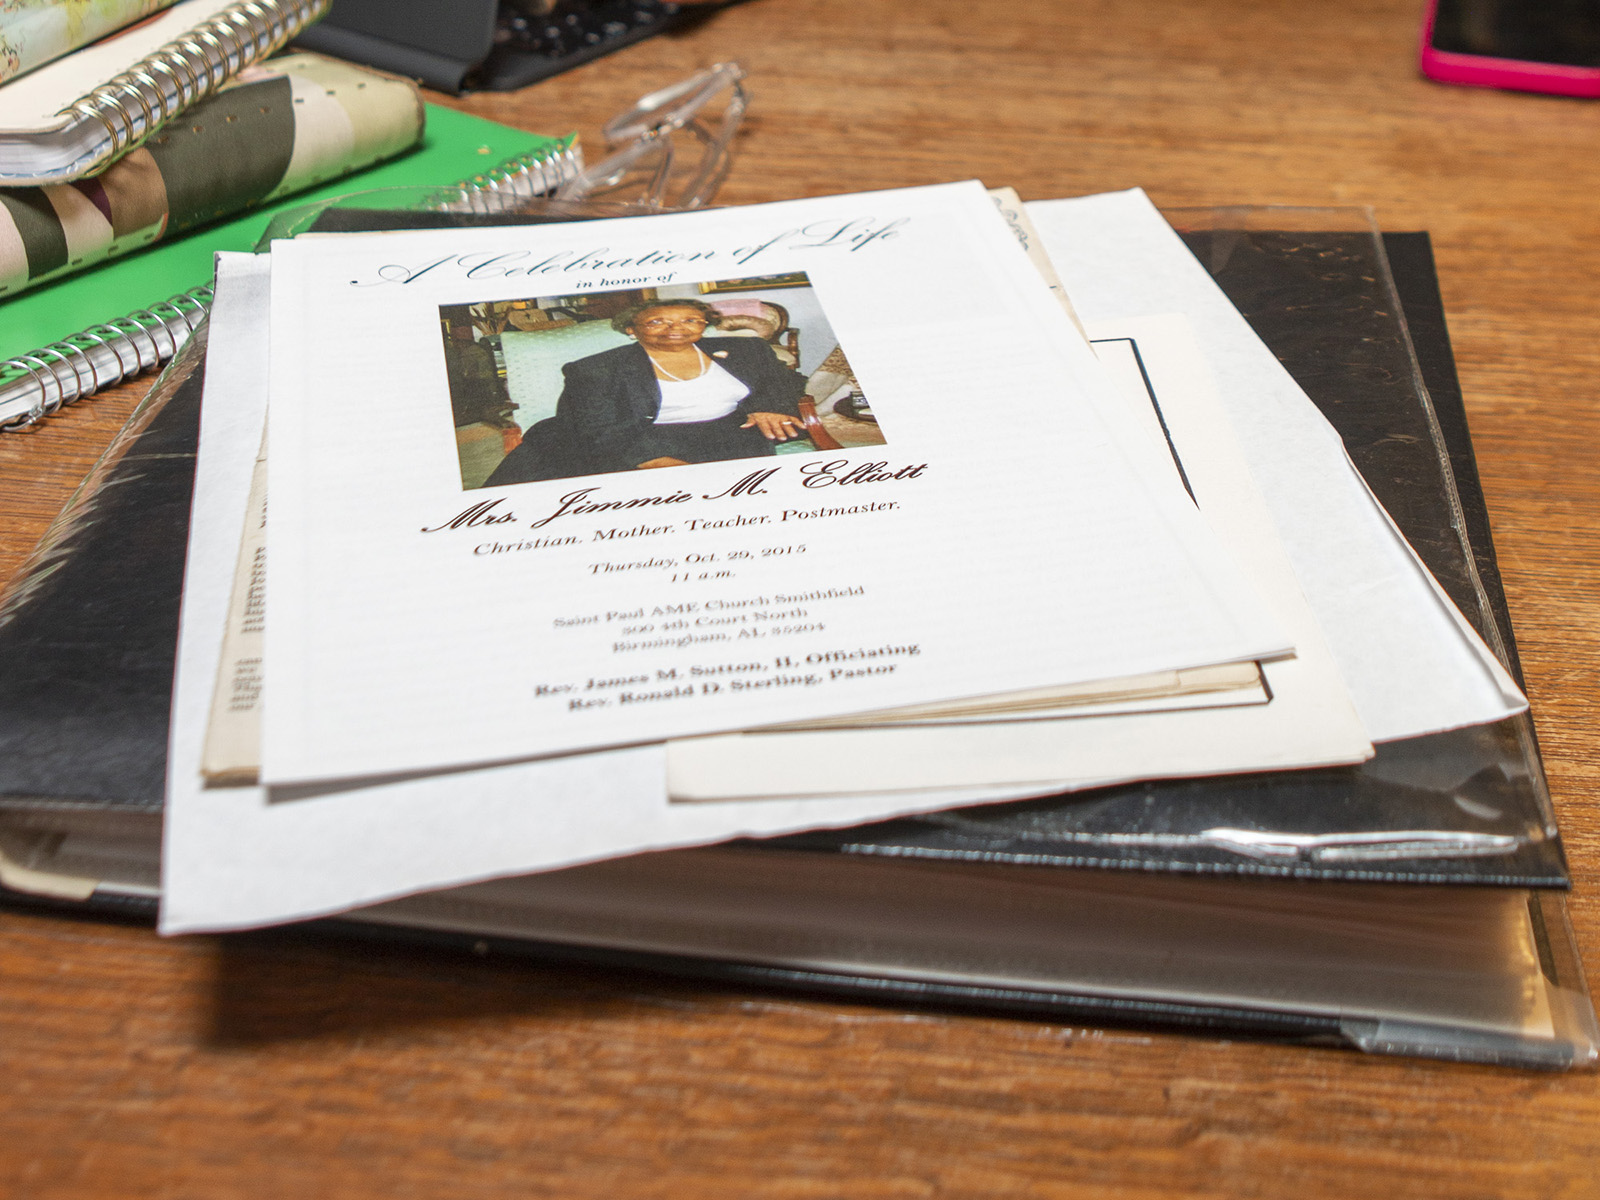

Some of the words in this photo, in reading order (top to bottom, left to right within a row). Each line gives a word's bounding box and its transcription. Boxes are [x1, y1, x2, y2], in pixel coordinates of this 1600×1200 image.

[350, 253, 458, 287] A
[457, 247, 715, 281] Celebration
[733, 228, 800, 265] of
[789, 216, 911, 252] Life
[575, 278, 595, 289] in
[600, 275, 652, 287] honor
[657, 272, 678, 285] of
[420, 496, 518, 533] Mrs.
[530, 486, 693, 529] Jimmie
[702, 466, 782, 501] M.
[799, 459, 929, 489] Elliott
[473, 533, 584, 556] Christian.
[592, 523, 677, 543] Mother.
[684, 513, 772, 532] Teacher.
[781, 499, 901, 523] Postmaster.
[588, 556, 679, 575] Thursday,
[685, 551, 721, 564] Oct.
[728, 550, 755, 562] 29,
[761, 543, 808, 557] 2015
[671, 572, 690, 583] 11
[698, 569, 736, 580] a.m.
[553, 614, 600, 629] Saint
[606, 607, 646, 622] Paul
[651, 601, 700, 617] AME
[704, 596, 770, 611] Church
[775, 585, 866, 604] Smithfield
[695, 614, 748, 628] Court
[752, 606, 808, 622] North
[612, 631, 732, 653] Birmingham,
[534, 683, 578, 699] Rev.
[585, 673, 650, 692] James
[656, 667, 684, 682] M.
[689, 660, 769, 677] Sutton,
[805, 643, 922, 665] Officiating
[568, 697, 613, 712] Rev.
[619, 684, 695, 706] Ronald
[729, 673, 824, 692] Sterling,
[829, 663, 898, 681] Pastor
